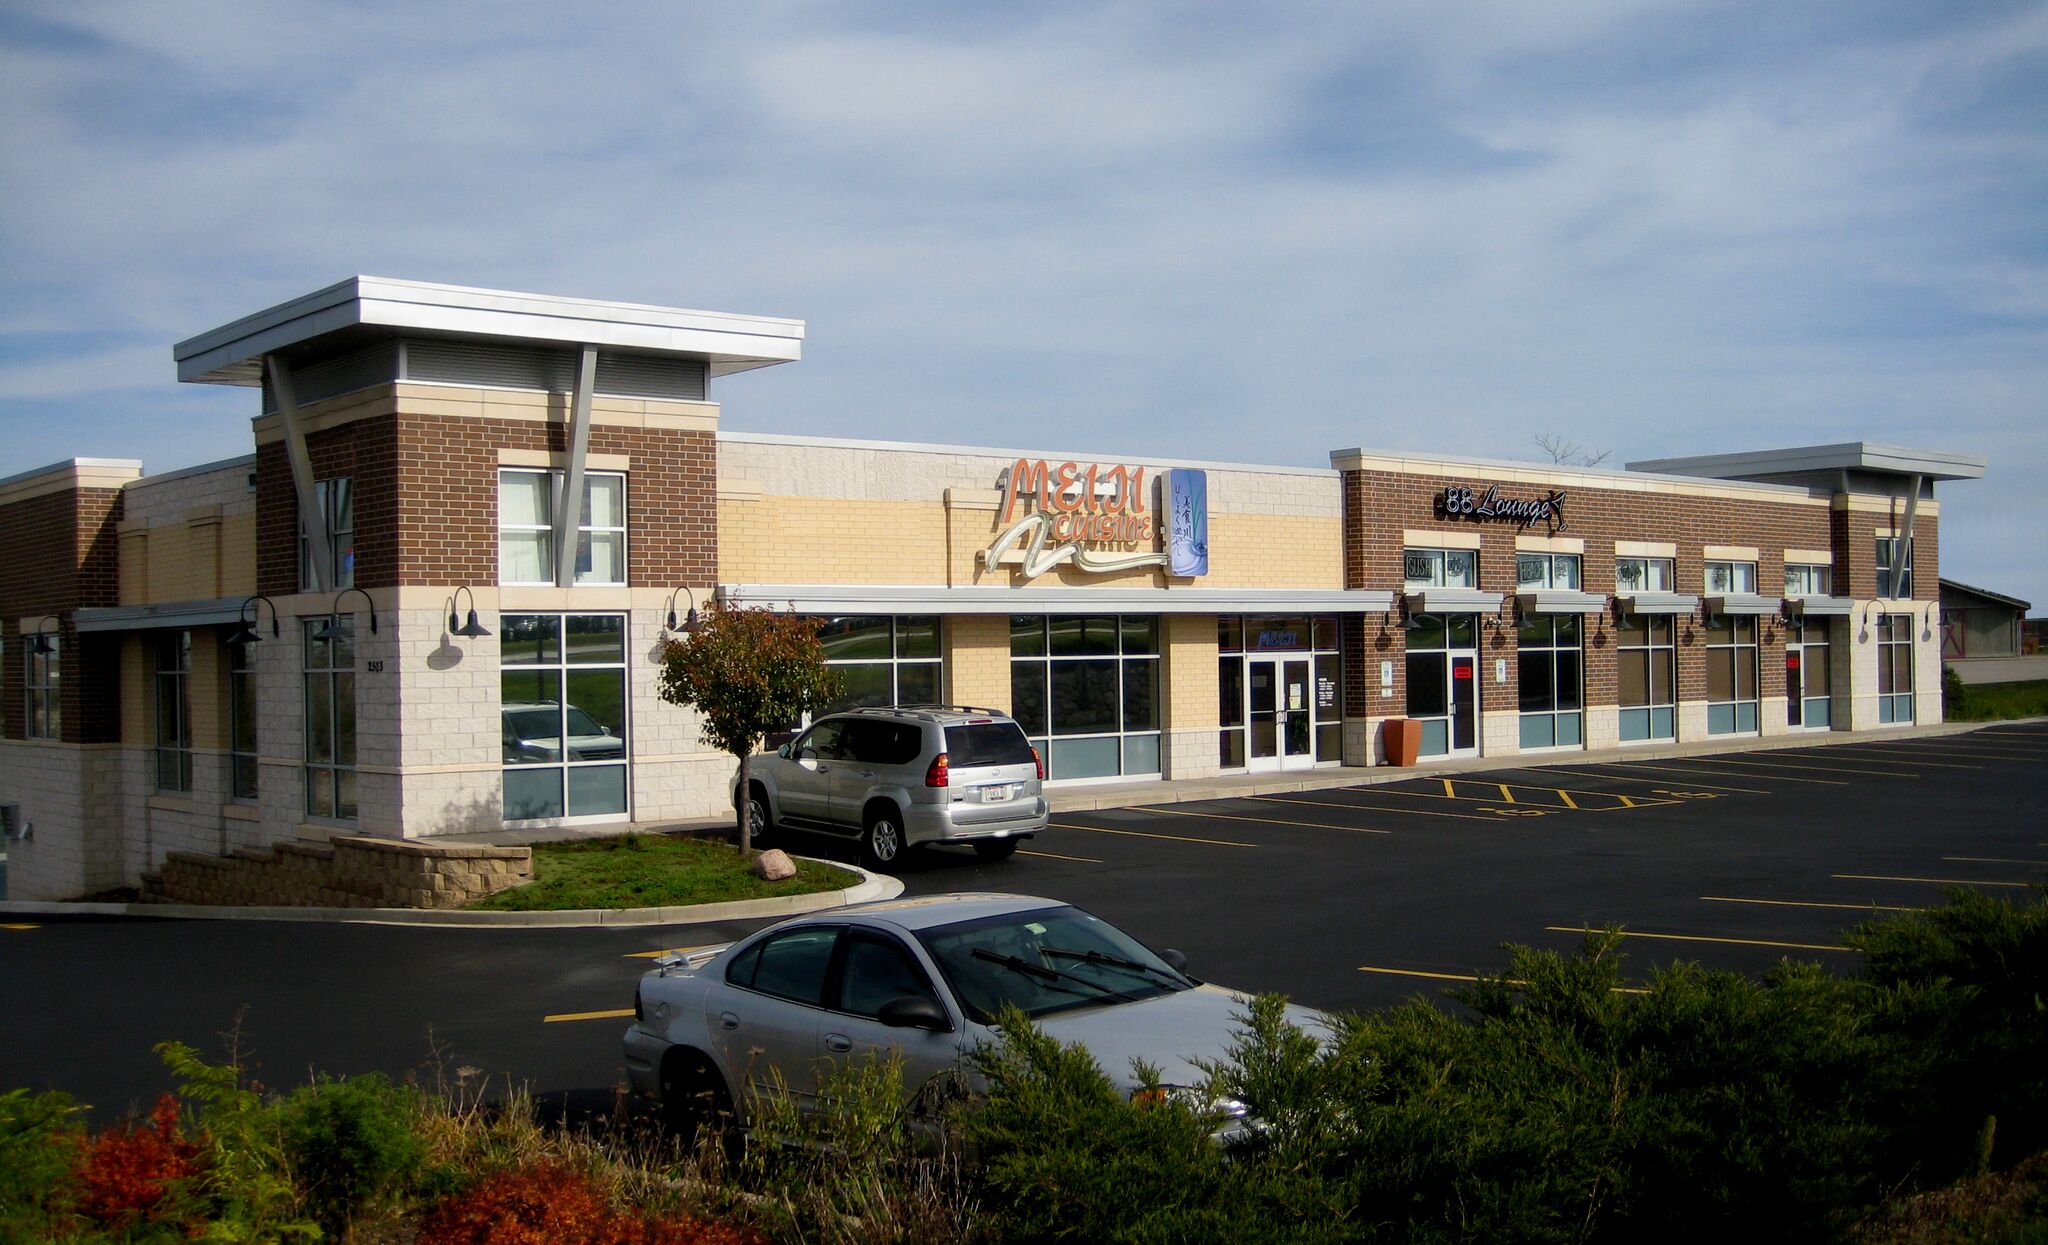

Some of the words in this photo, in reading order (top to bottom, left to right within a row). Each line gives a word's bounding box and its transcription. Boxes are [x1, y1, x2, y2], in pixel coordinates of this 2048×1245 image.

[1003, 458, 1146, 524] MEIJI
[1445, 486, 1473, 514] 88
[1476, 484, 1551, 528] Lounge
